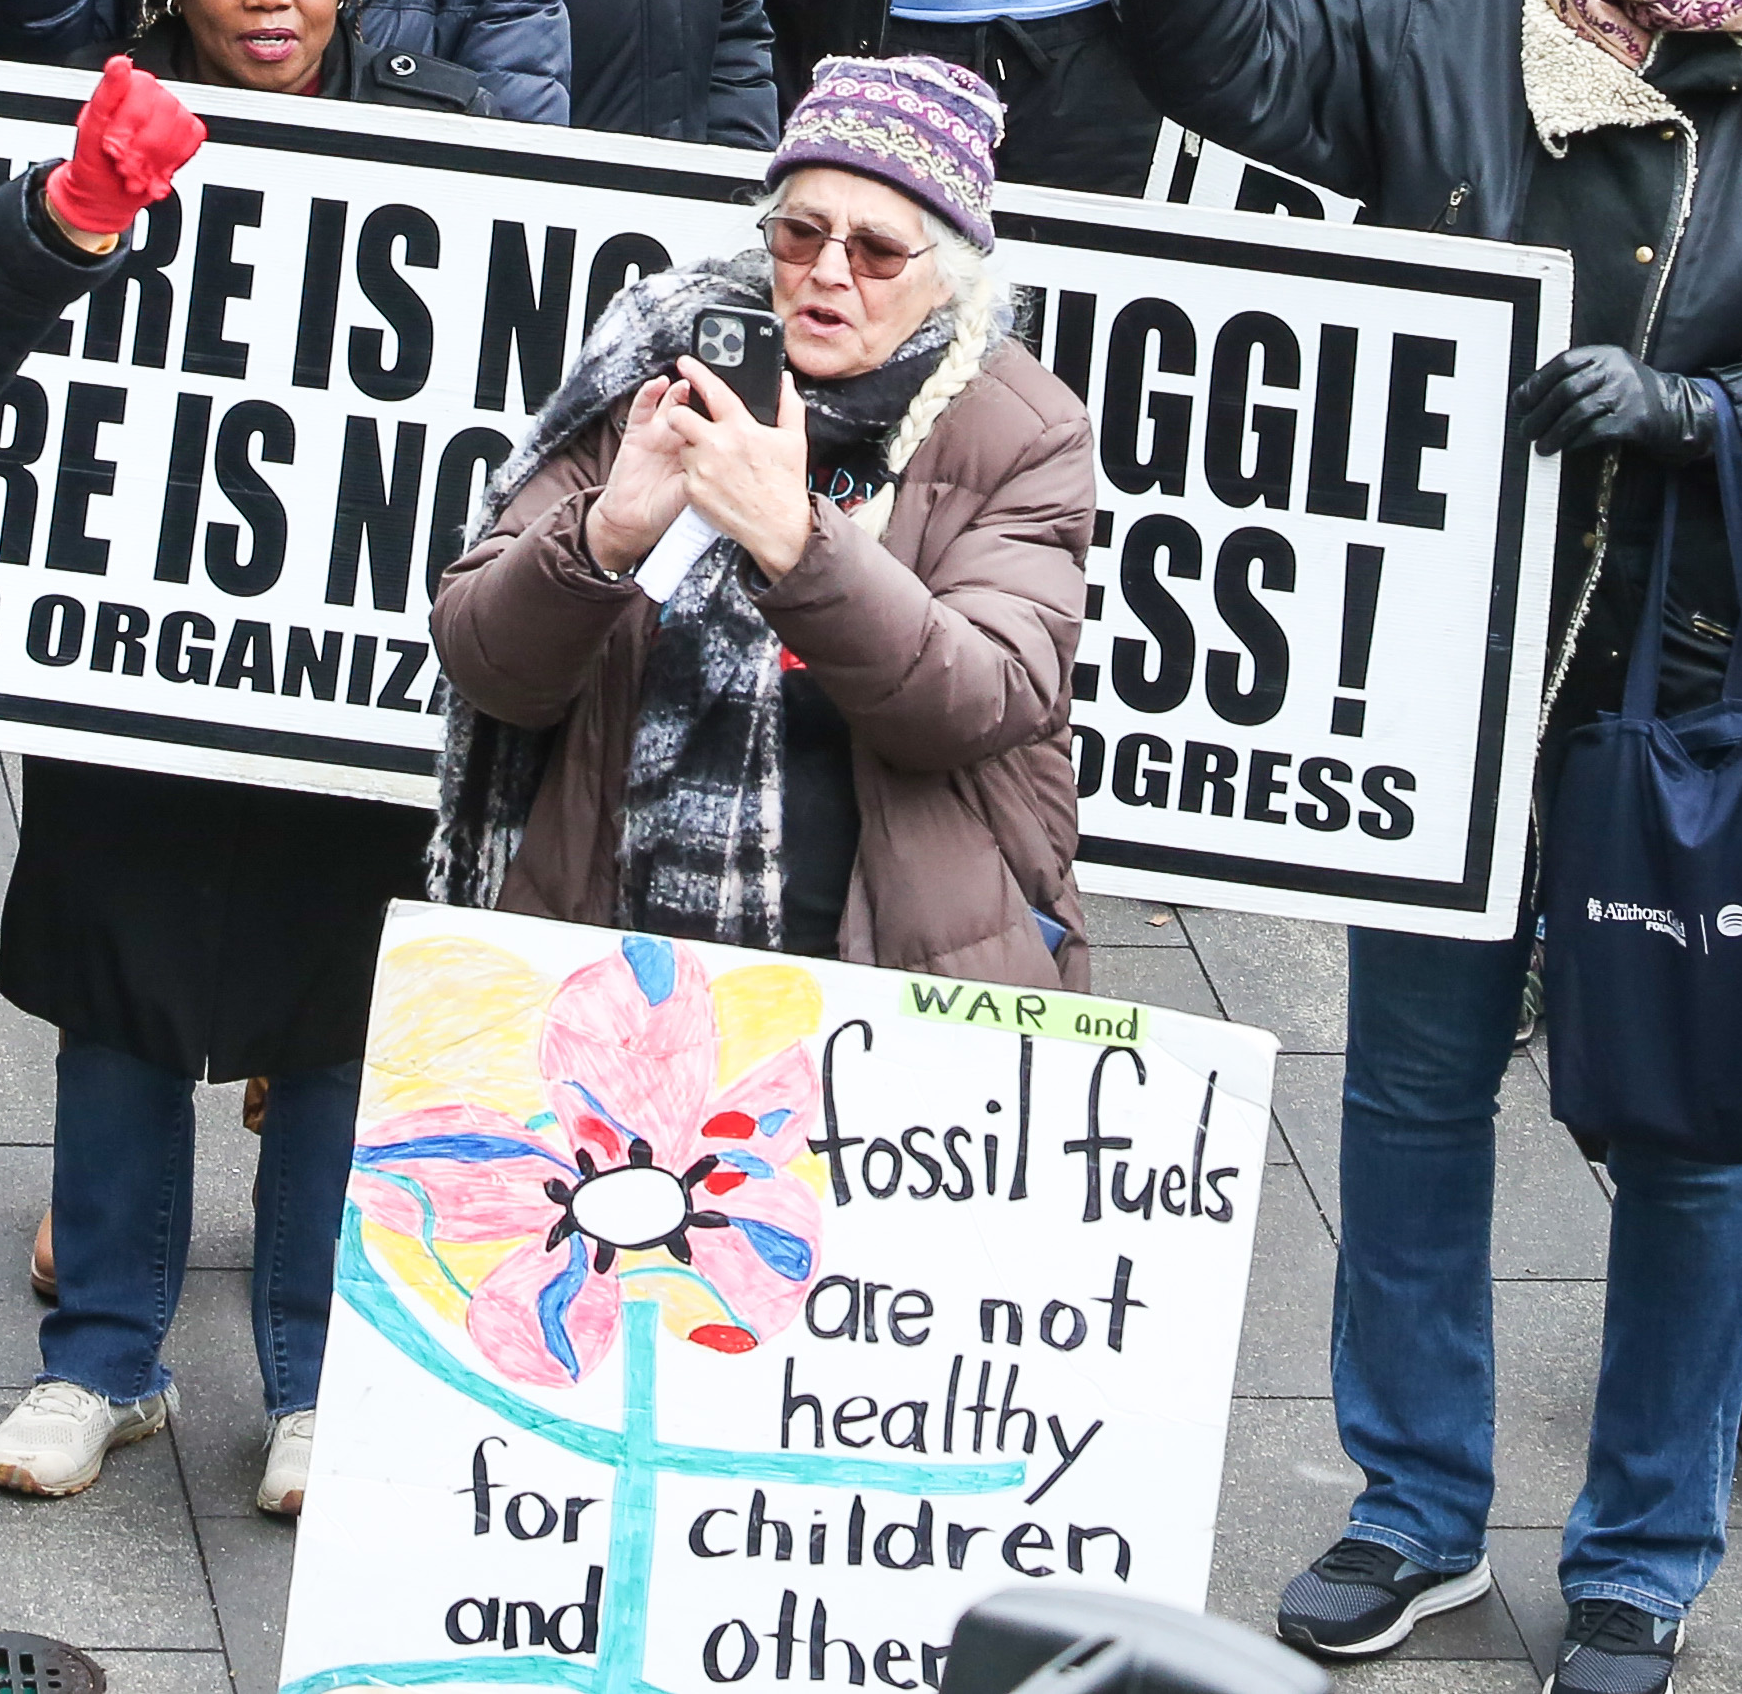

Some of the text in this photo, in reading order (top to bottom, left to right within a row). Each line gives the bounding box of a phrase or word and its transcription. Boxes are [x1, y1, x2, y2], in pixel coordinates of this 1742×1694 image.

[291, 197, 440, 402] IS
[154, 391, 297, 598] IS
[25, 593, 440, 715] ORGANIZ
[1603, 902, 1667, 922] Authors
[910, 982, 1139, 1043] WAR and
[806, 1019, 1239, 1224] fossil fuels
[805, 1254, 1149, 1353] are not
[780, 1355, 1104, 1504] healthy
[455, 1437, 1131, 1582] for children
[445, 1565, 603, 1655] and
